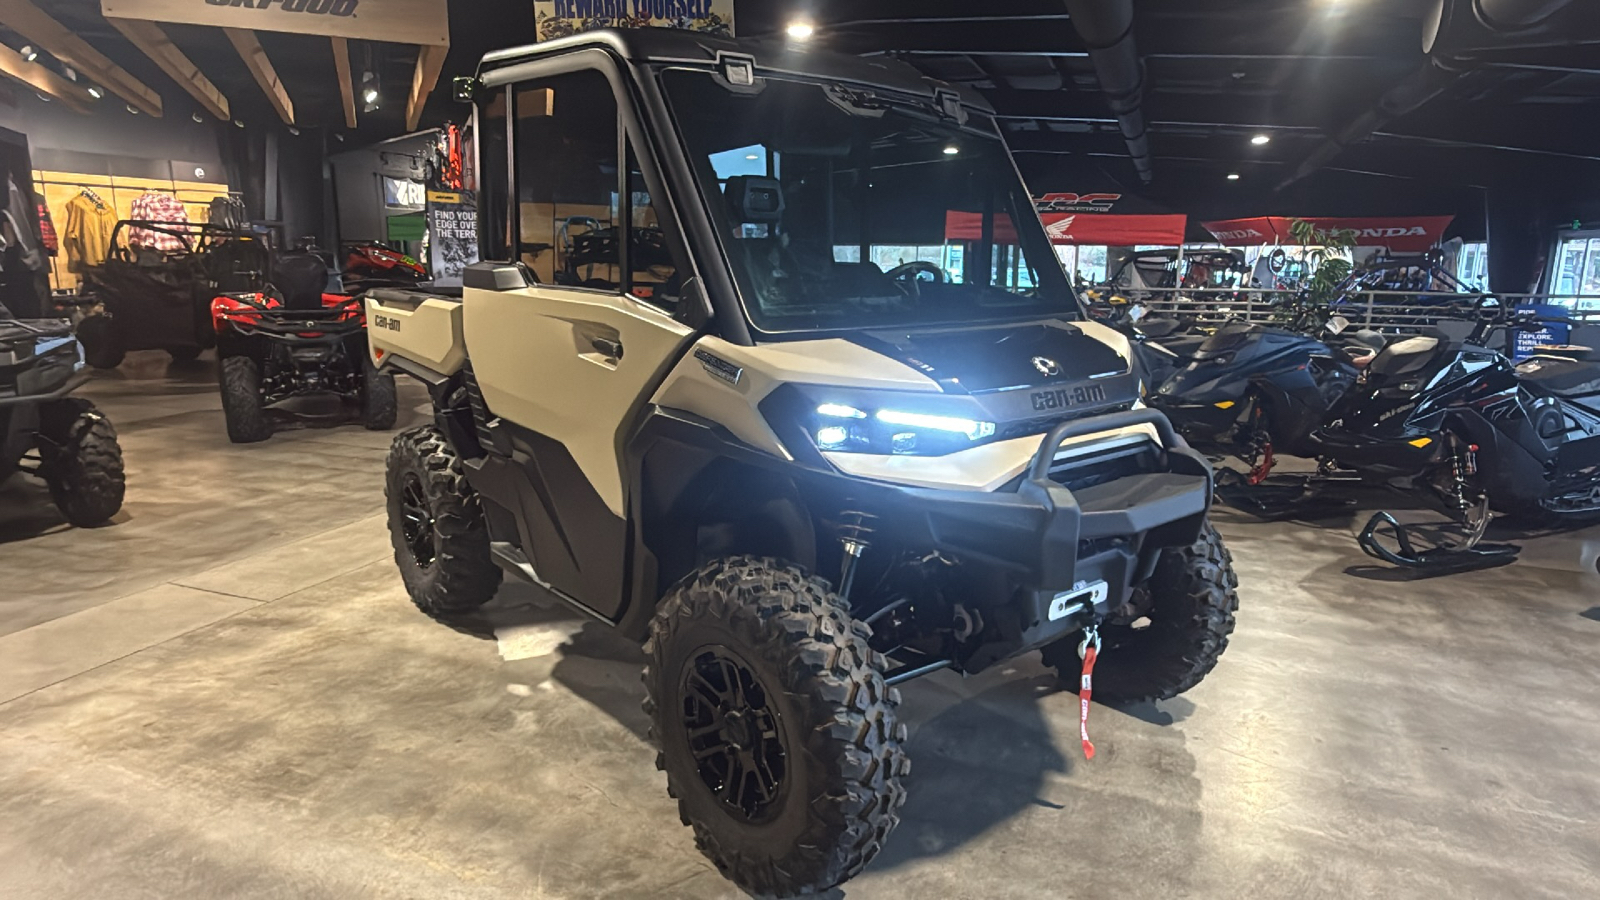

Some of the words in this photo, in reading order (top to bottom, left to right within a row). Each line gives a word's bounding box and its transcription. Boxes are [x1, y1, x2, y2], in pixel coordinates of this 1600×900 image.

[435, 210, 455, 220] FIND
[435, 220, 458, 229] EDGE
[460, 221, 478, 230] OVE
[435, 228, 453, 238] THE
